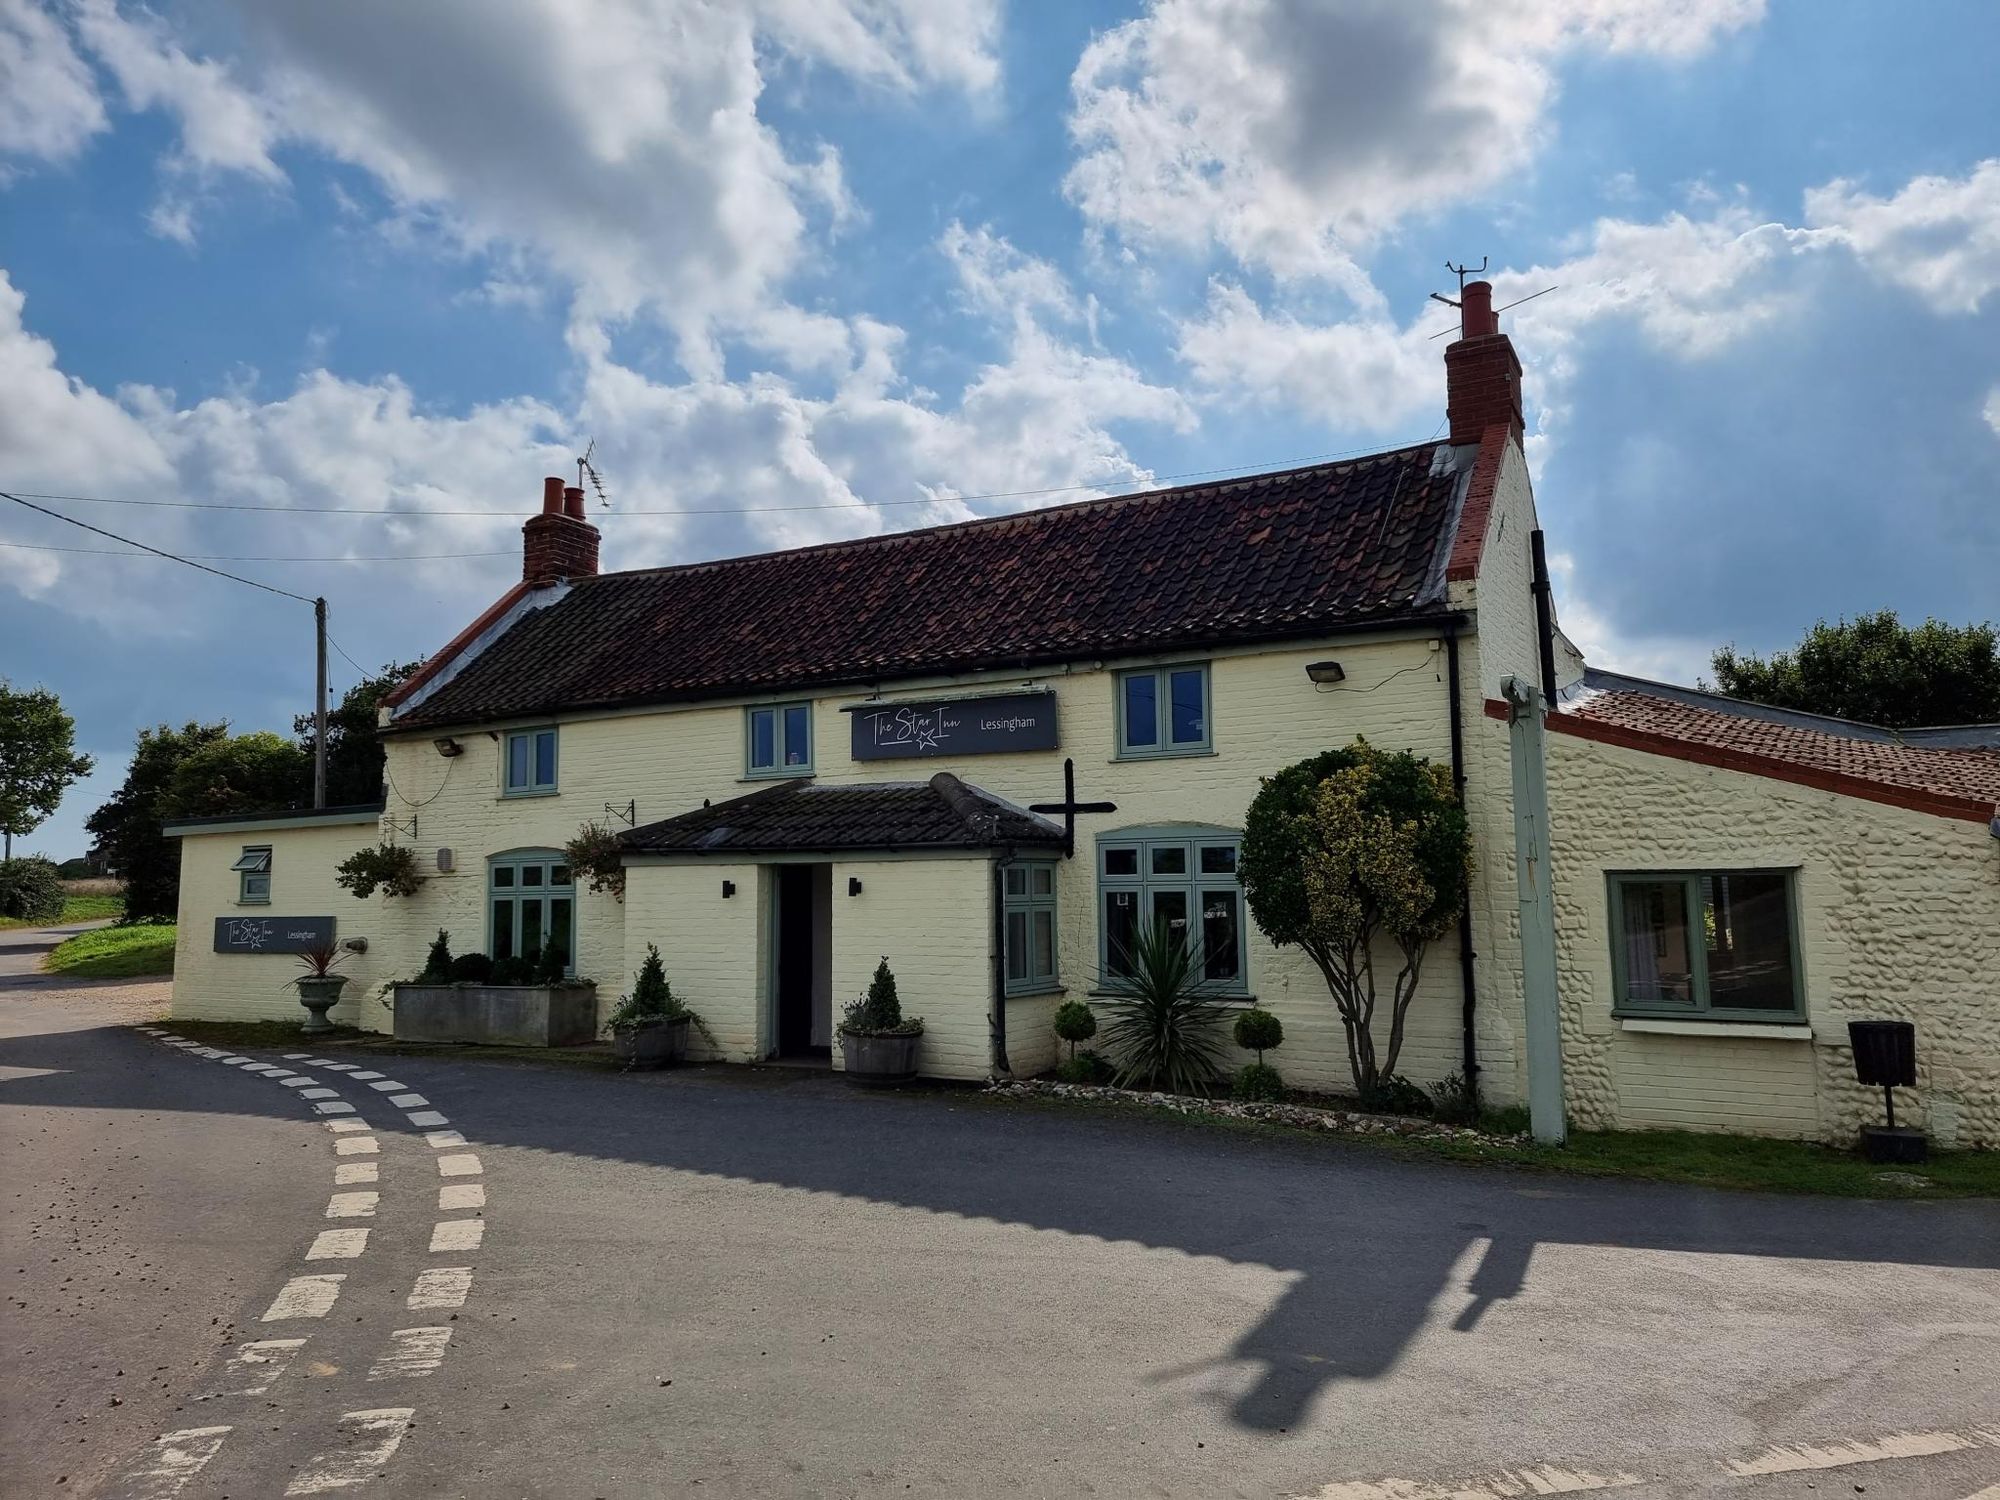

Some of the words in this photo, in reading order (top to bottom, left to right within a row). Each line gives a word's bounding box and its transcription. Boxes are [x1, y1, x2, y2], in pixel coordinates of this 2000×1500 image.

[864, 711, 893, 745] The
[895, 707, 931, 741] Star
[932, 706, 960, 739] Inn
[980, 716, 1036, 732] Lessingham
[225, 920, 239, 944] The
[240, 919, 259, 941] Star
[259, 920, 274, 942] Inn
